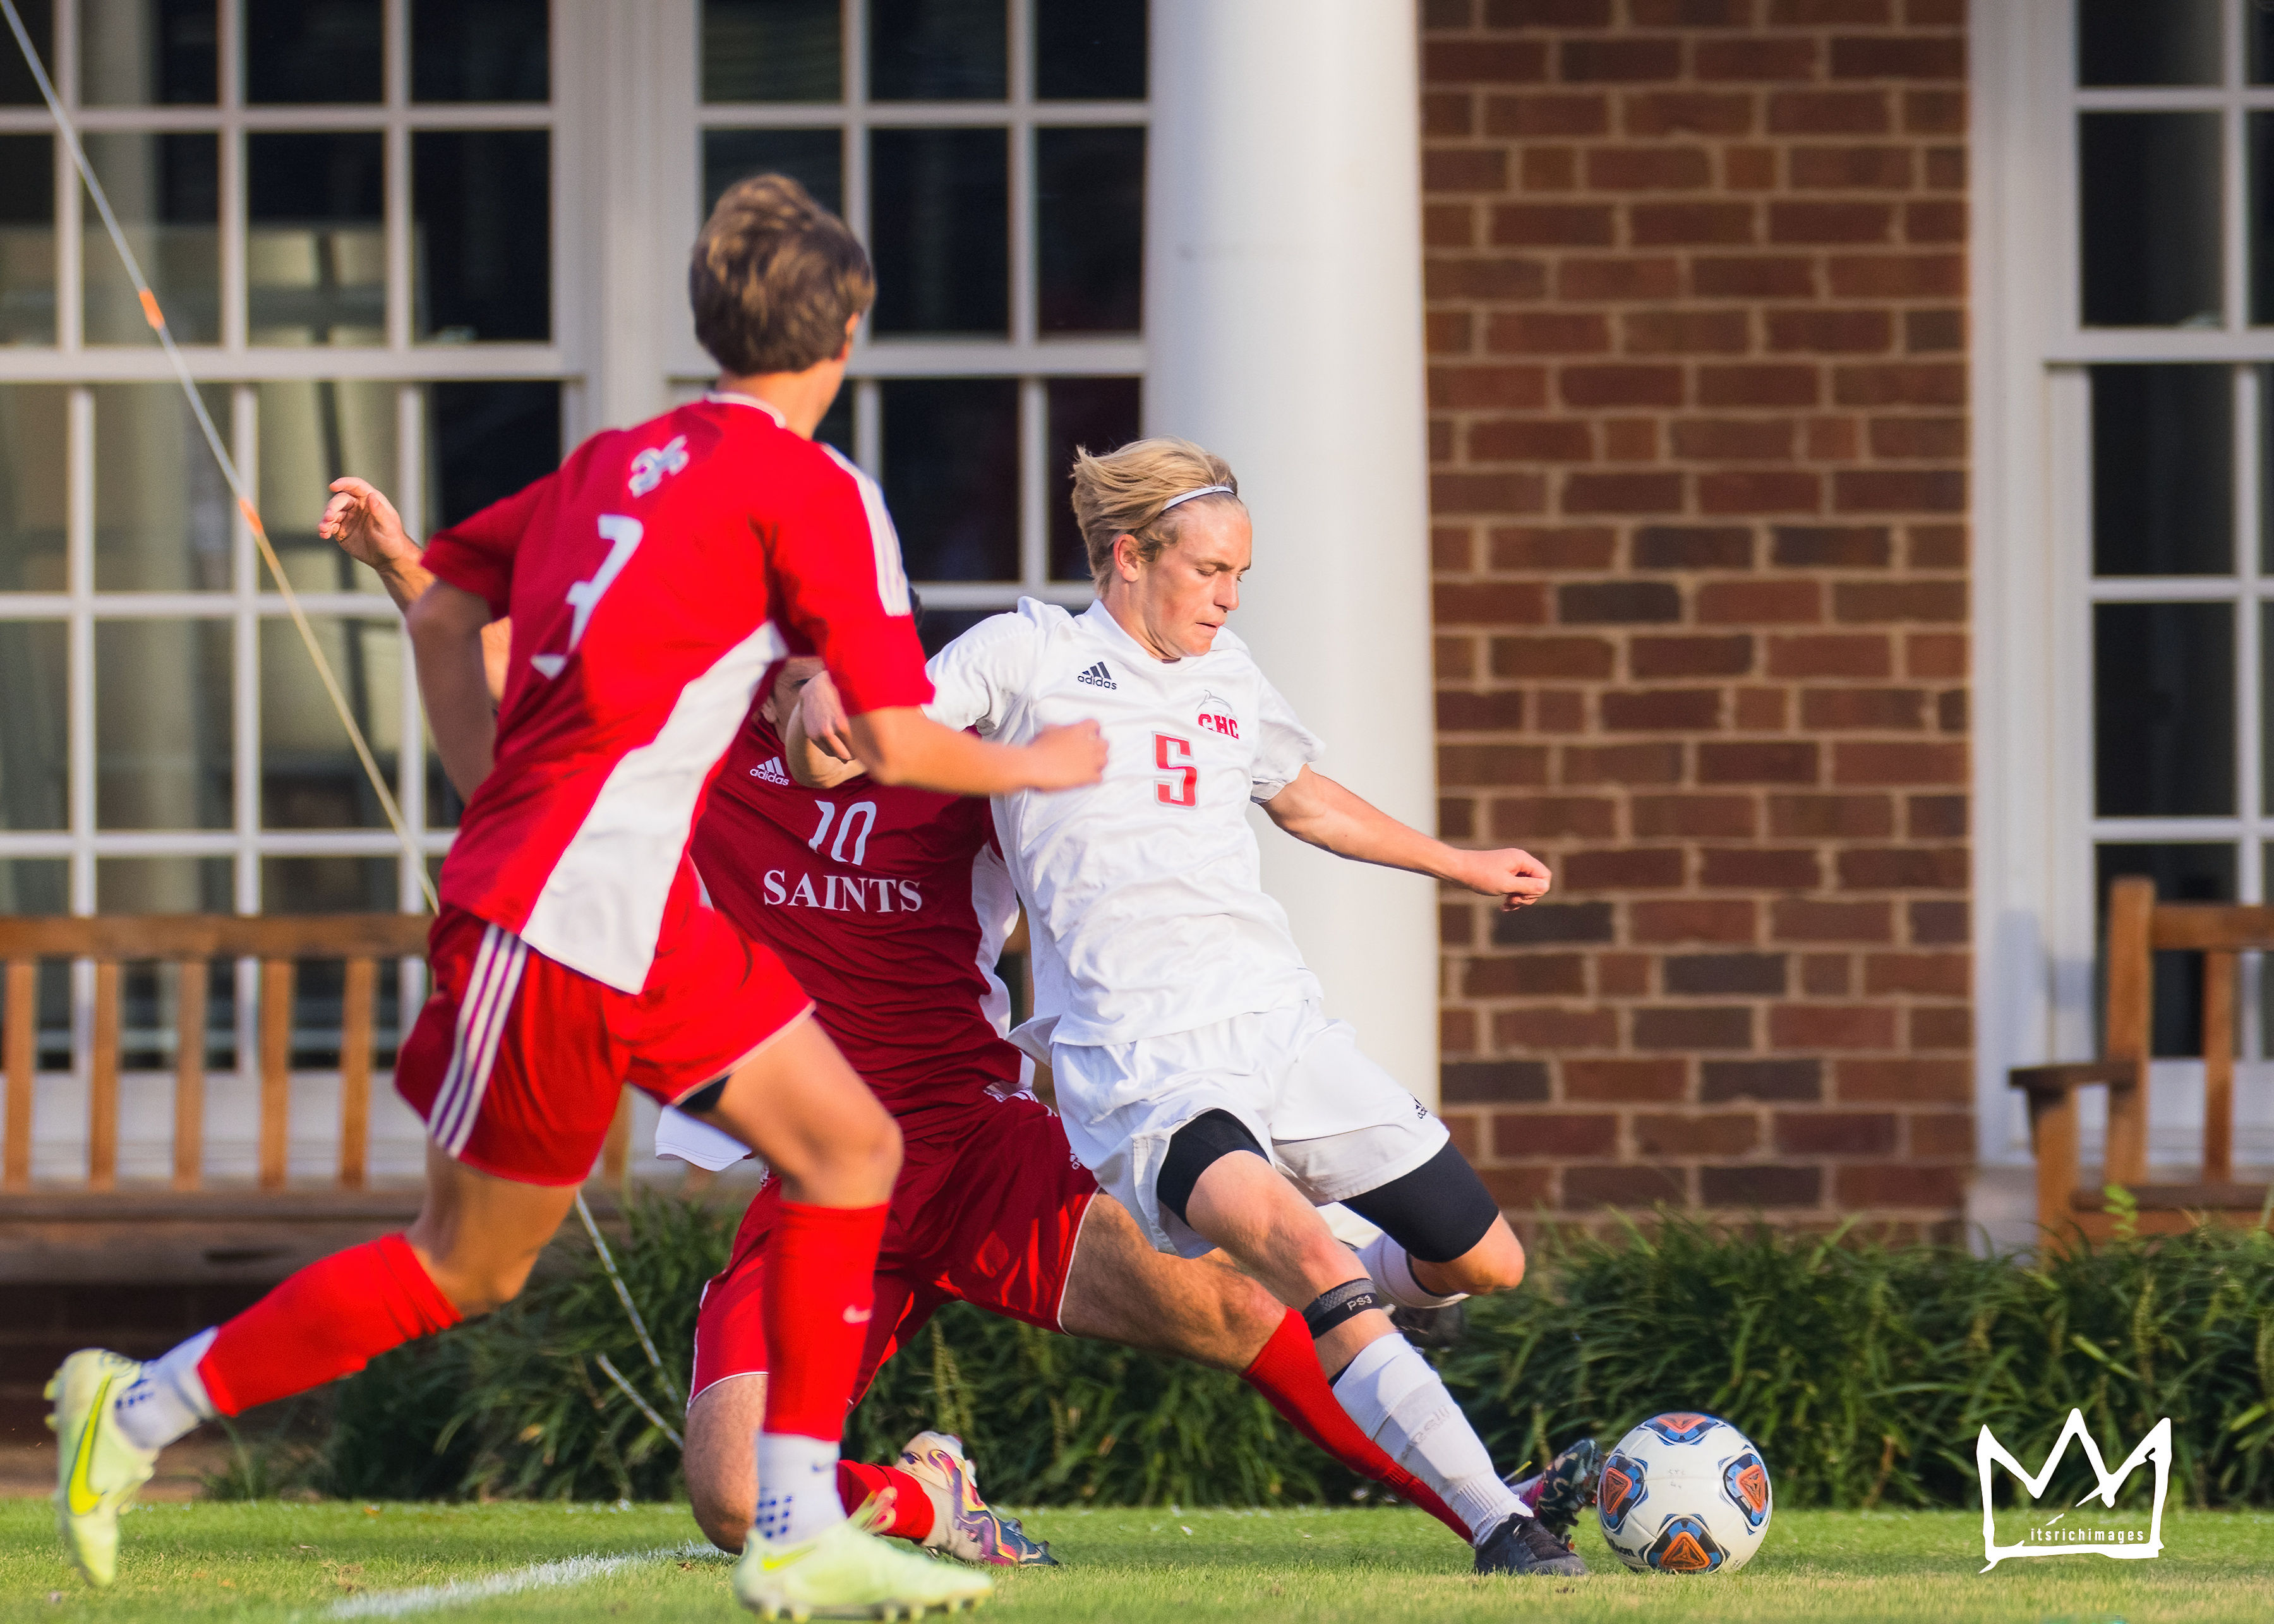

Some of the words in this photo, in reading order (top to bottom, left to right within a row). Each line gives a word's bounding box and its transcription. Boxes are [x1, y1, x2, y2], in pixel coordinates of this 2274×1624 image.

[1077, 674, 1117, 690] adidas
[1198, 714, 1239, 740] CHC
[750, 767, 790, 786] adidas
[1153, 732, 1198, 809] 5
[808, 800, 877, 866] 10
[763, 869, 923, 913] SAINTS
